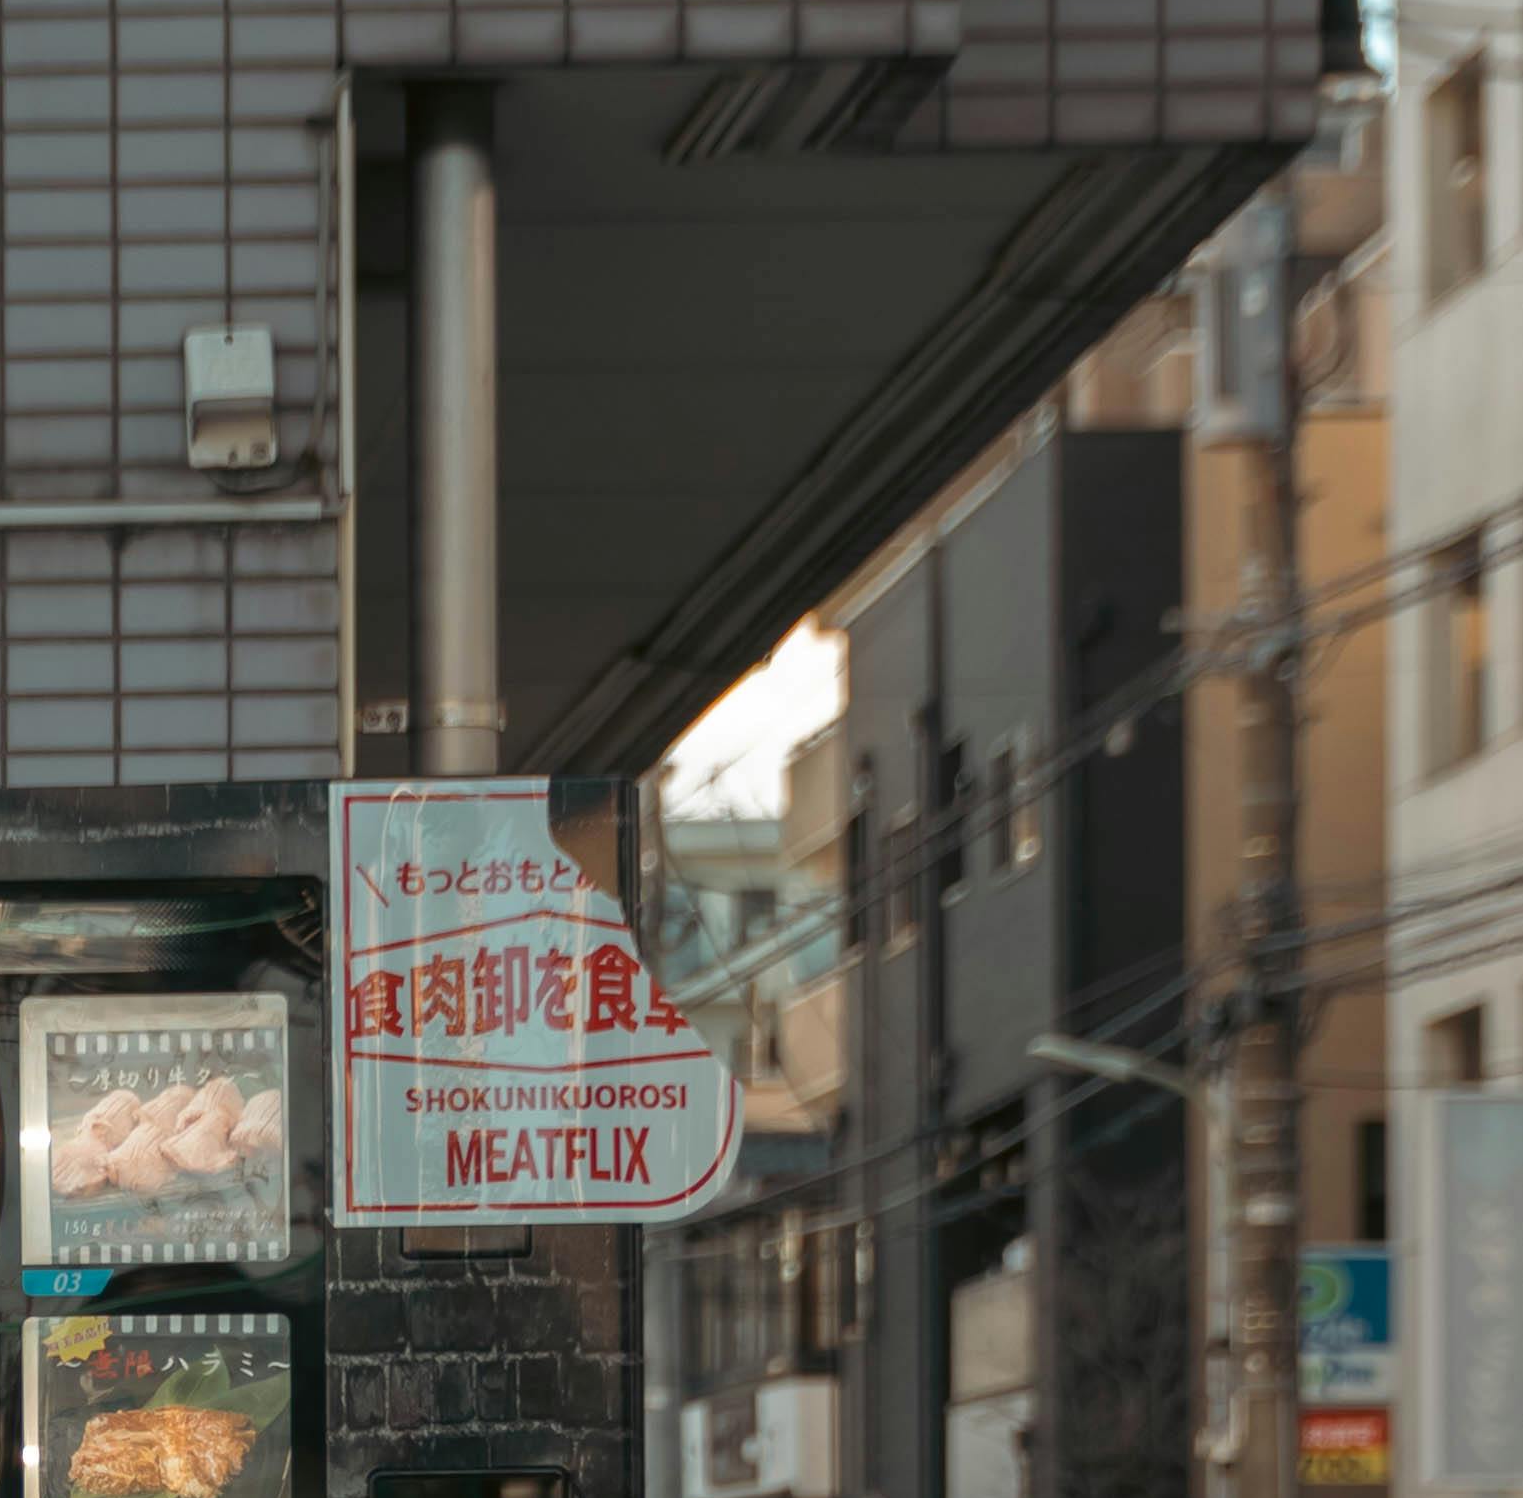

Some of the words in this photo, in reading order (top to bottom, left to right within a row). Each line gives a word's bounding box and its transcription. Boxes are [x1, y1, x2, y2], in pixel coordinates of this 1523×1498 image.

[404, 1084, 687, 1114] SHOKUNIKUOROSI
[446, 1124, 651, 1188] MEATFLIX
[53, 1272, 81, 1293] 03
